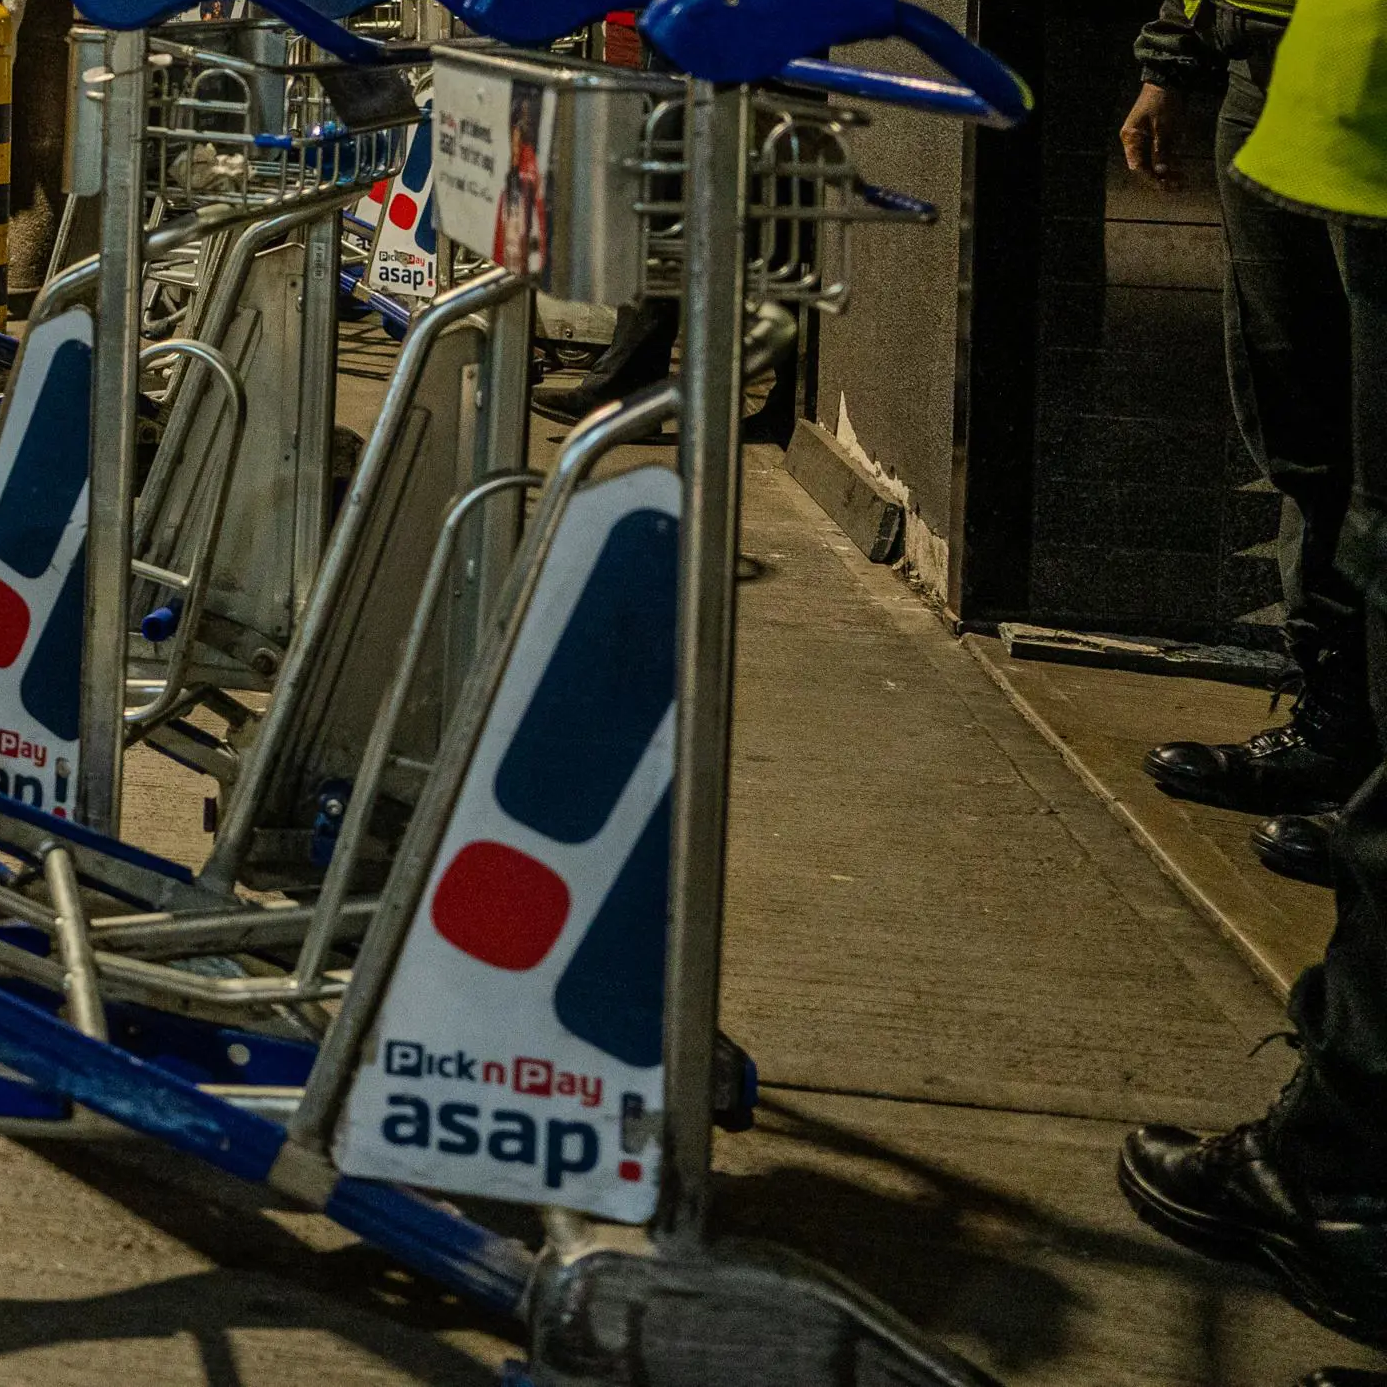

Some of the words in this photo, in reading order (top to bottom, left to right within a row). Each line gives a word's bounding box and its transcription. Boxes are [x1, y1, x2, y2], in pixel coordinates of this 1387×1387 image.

[378, 261, 434, 291] asap!
[385, 1039, 477, 1082] Pick
[483, 1060, 507, 1085] n
[512, 1056, 603, 1107] Pay
